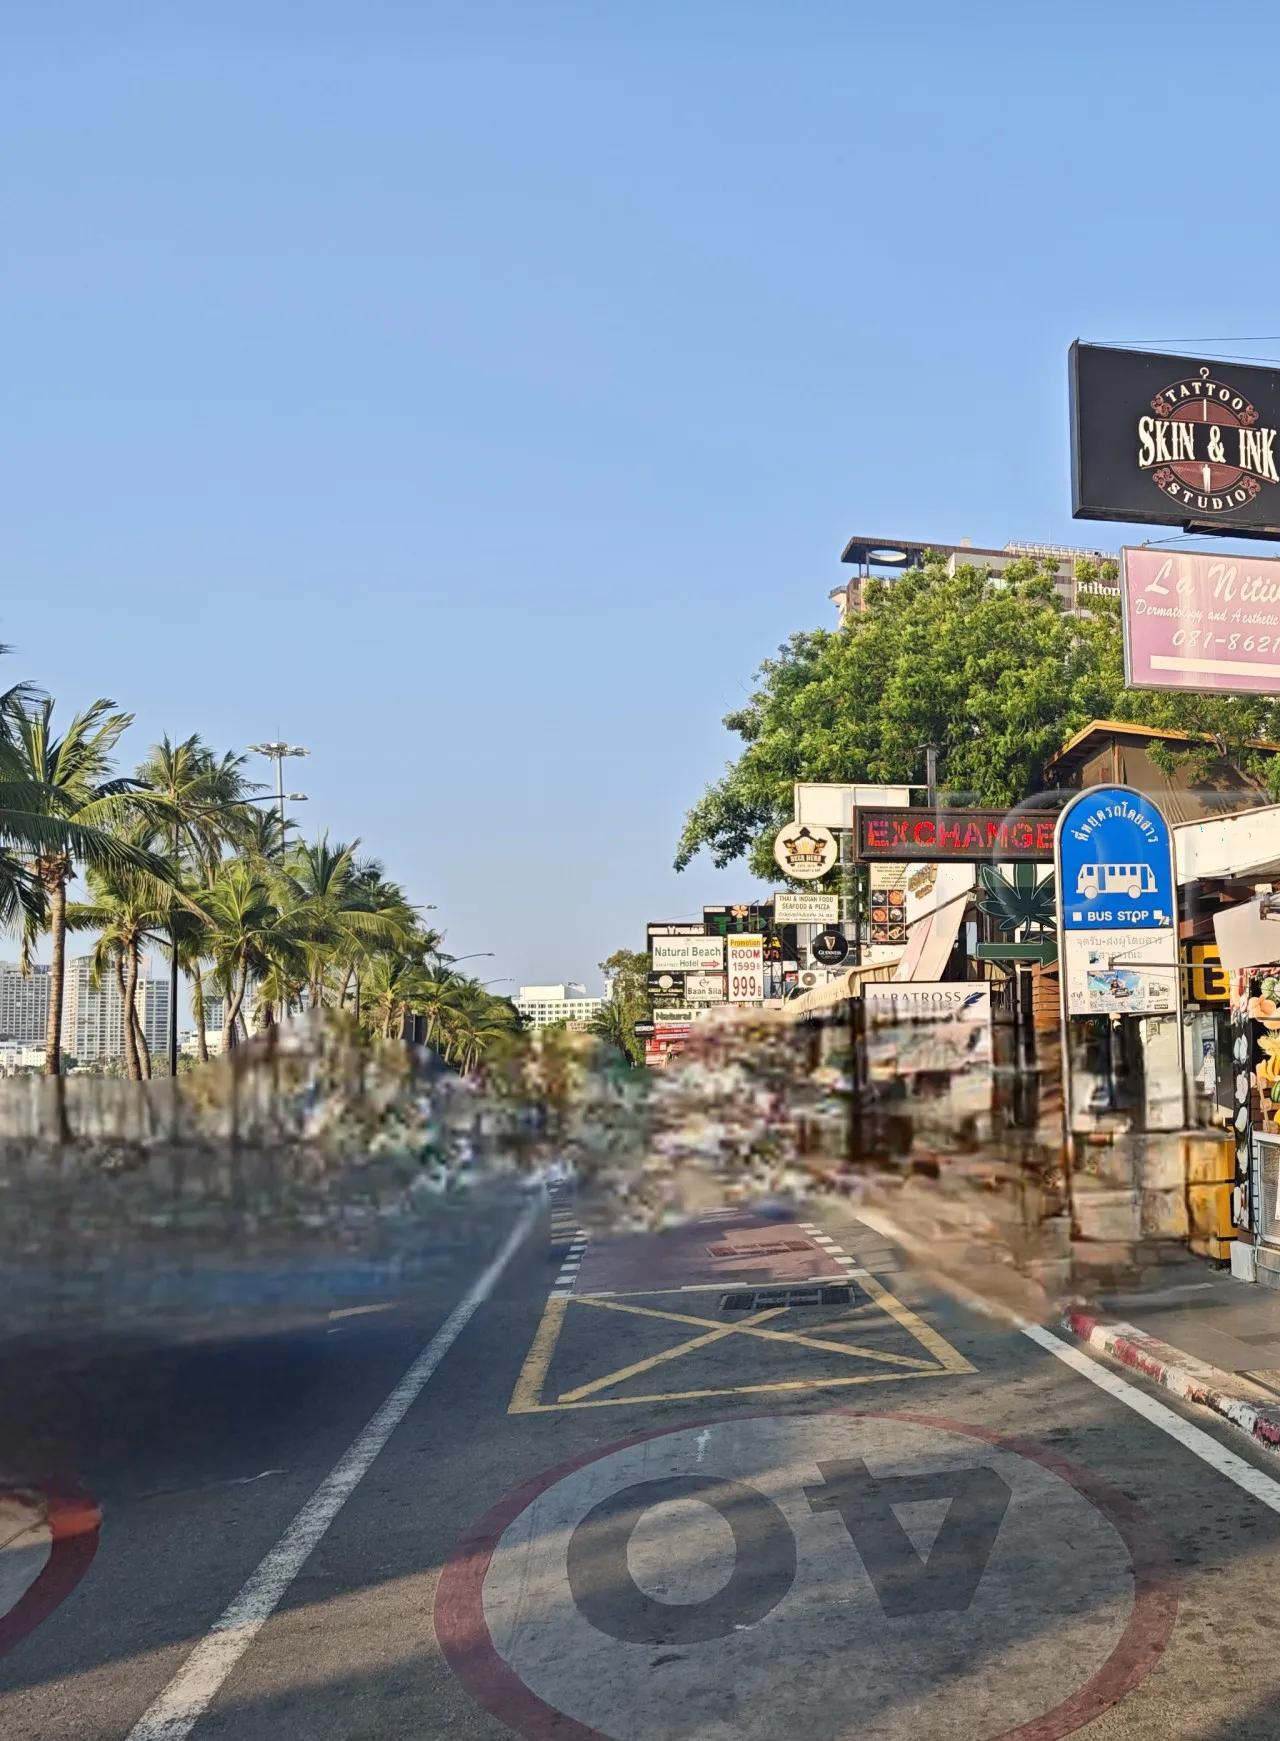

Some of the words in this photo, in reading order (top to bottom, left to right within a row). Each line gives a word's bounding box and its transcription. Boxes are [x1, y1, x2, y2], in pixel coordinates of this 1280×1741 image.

[1165, 381, 1243, 410] TATTOO
[1138, 415, 1196, 467] SKIN
[1207, 425, 1226, 464] &
[1238, 427, 1280, 483] INK
[1167, 481, 1247, 510] STUDIO
[1077, 581, 1121, 596] Hilton
[1145, 558, 1196, 597] La
[1135, 598, 1203, 624] Dermatology
[1207, 610, 1228, 623] and
[1231, 607, 1279, 627] Aesthetic
[1070, 800, 1159, 844] ที่หยุดรถโดยสาร
[867, 820, 1056, 849] EXCHANGE
[1087, 911, 1113, 922] BUS
[1117, 910, 1149, 923] STOP
[654, 946, 691, 957] Natural
[691, 946, 722, 957] Beach
[730, 939, 760, 948] Promotion
[731, 949, 761, 959] ROOM
[679, 959, 700, 968] Hotel
[687, 987, 707, 995] Baan
[707, 987, 722, 995] Sila
[732, 975, 756, 997] 999
